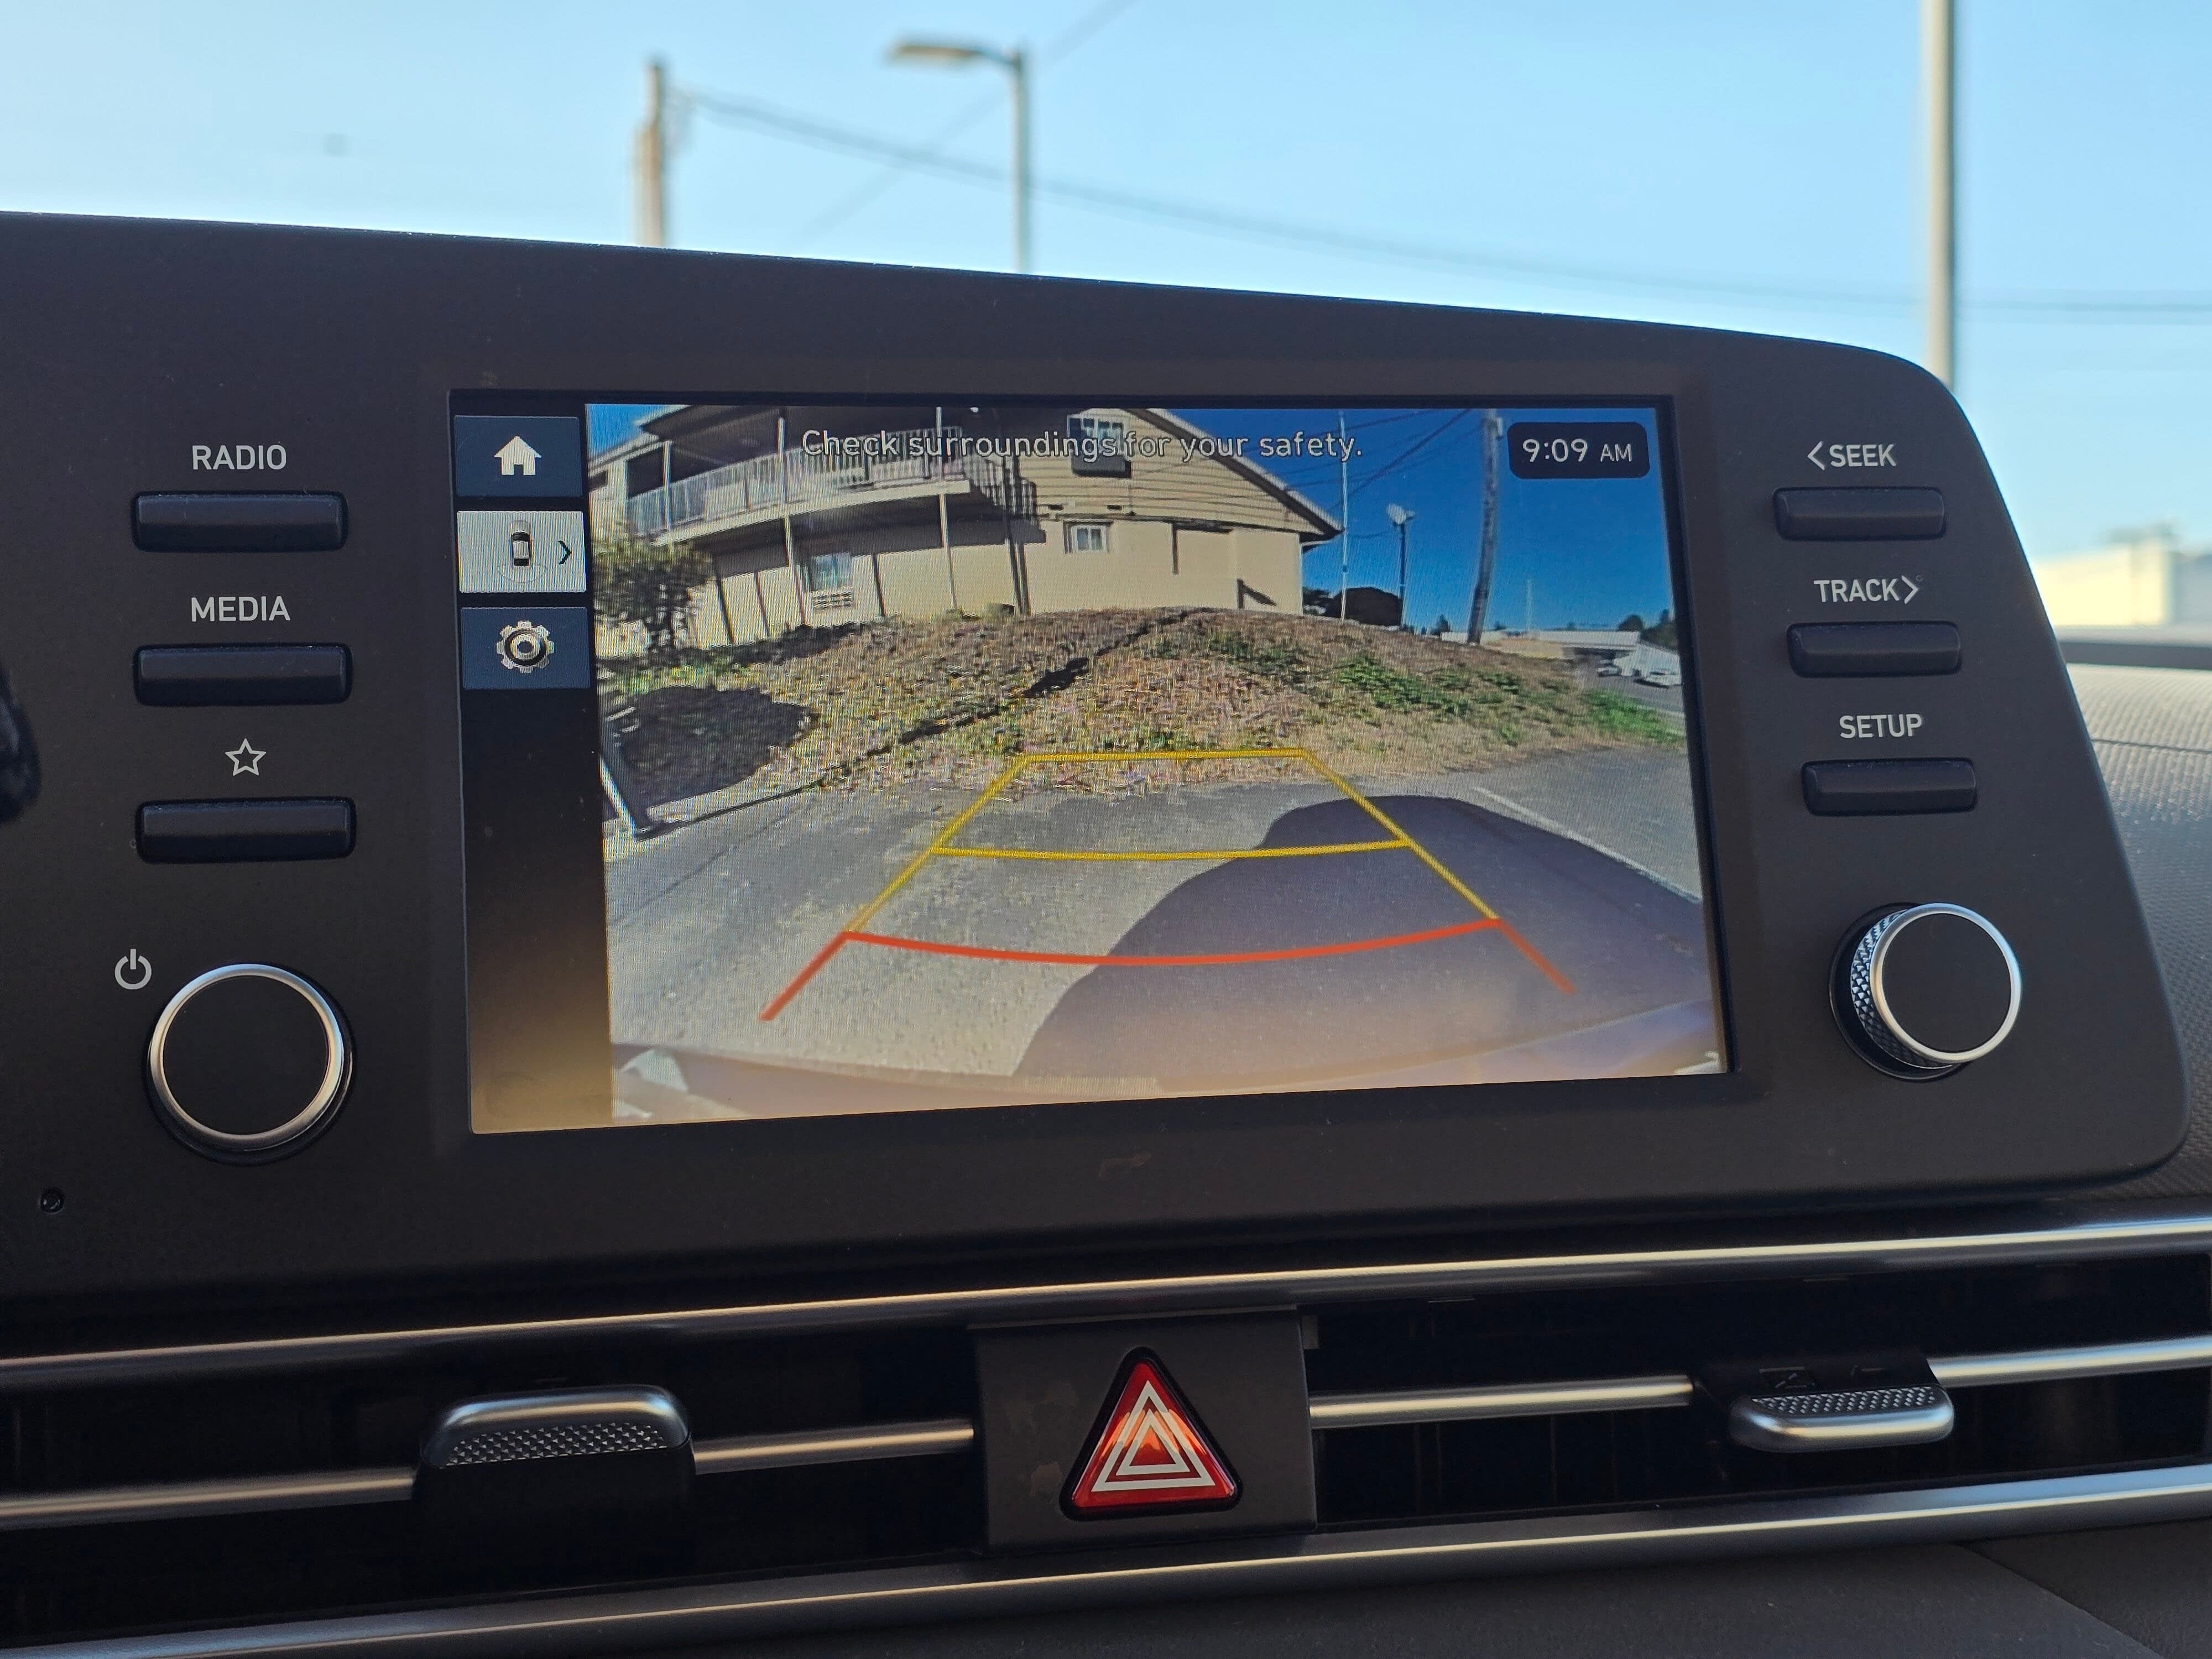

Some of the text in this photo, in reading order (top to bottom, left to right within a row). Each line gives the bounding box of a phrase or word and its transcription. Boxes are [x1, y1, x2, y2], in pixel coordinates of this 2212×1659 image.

[191, 445, 287, 470] RADIO
[801, 429, 1363, 463] Check surroundings for your safety.
[1522, 439, 1633, 463] 9:09 AM
[1829, 444, 1897, 467] SEEK
[1815, 579, 1898, 603] TRACK
[190, 596, 291, 622] MEDIA
[1839, 713, 1924, 739] SETUP
